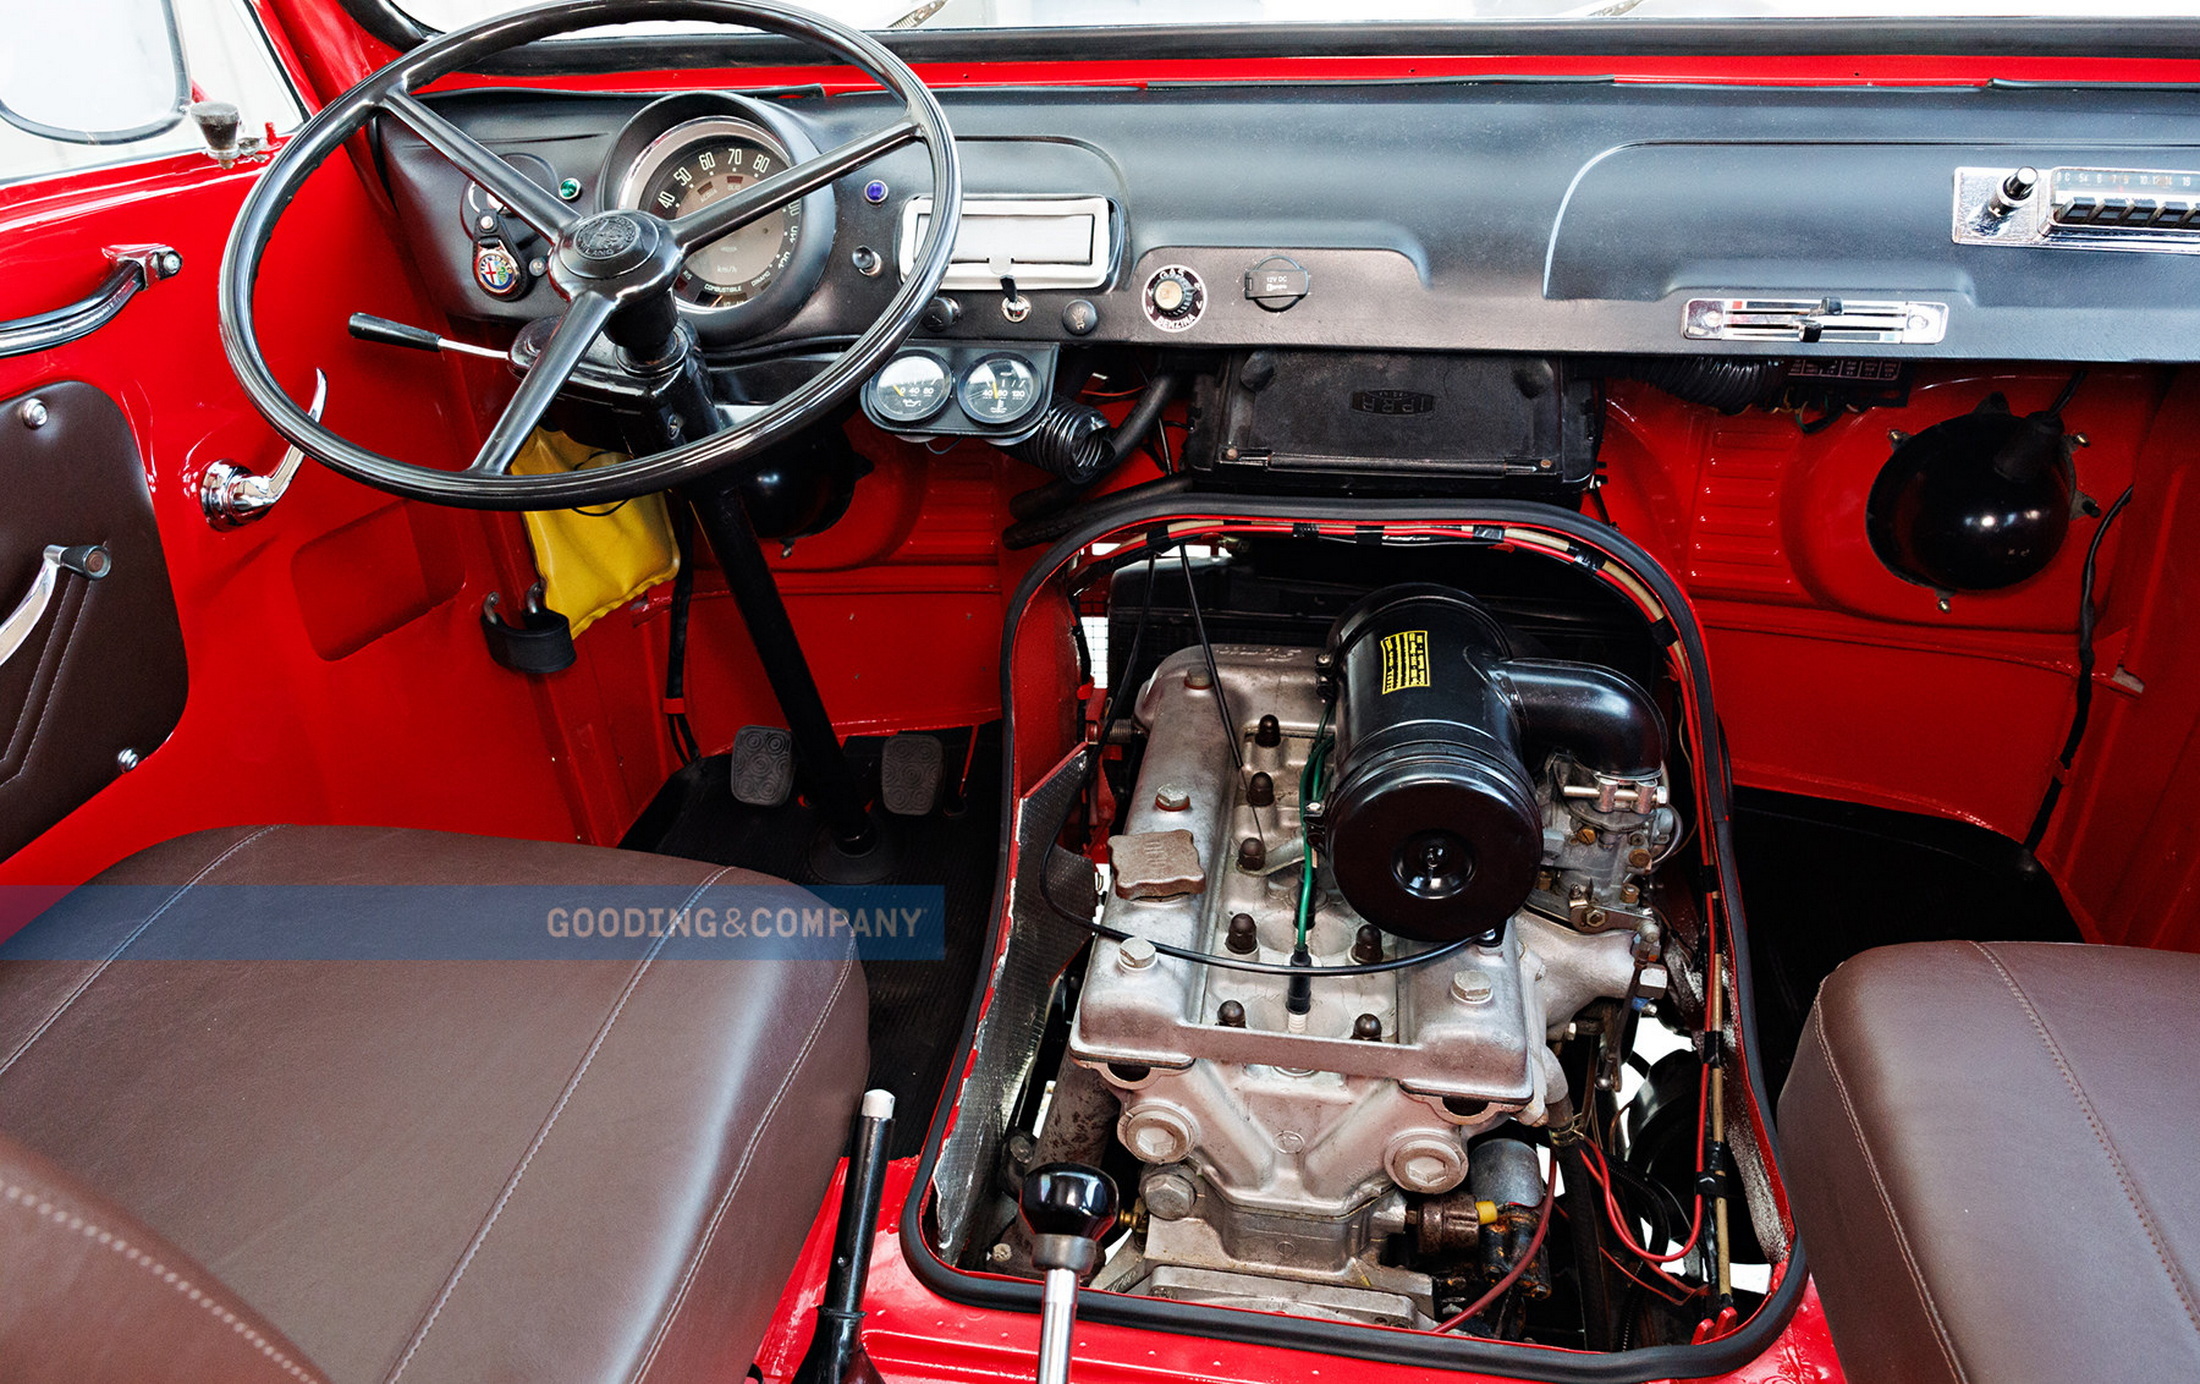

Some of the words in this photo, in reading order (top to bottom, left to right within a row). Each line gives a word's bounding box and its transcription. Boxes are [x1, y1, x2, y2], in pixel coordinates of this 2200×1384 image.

[699, 151, 716, 171] 60
[728, 148, 742, 165] 70
[753, 154, 770, 173] 80
[673, 166, 692, 187] 50
[657, 191, 675, 209] 40
[751, 270, 771, 287] DINAMO
[1160, 268, 1185, 280] GAS
[704, 283, 742, 293] COMBUSTIBILE
[1155, 313, 1196, 330] BENZINA
[982, 389, 993, 397] 40
